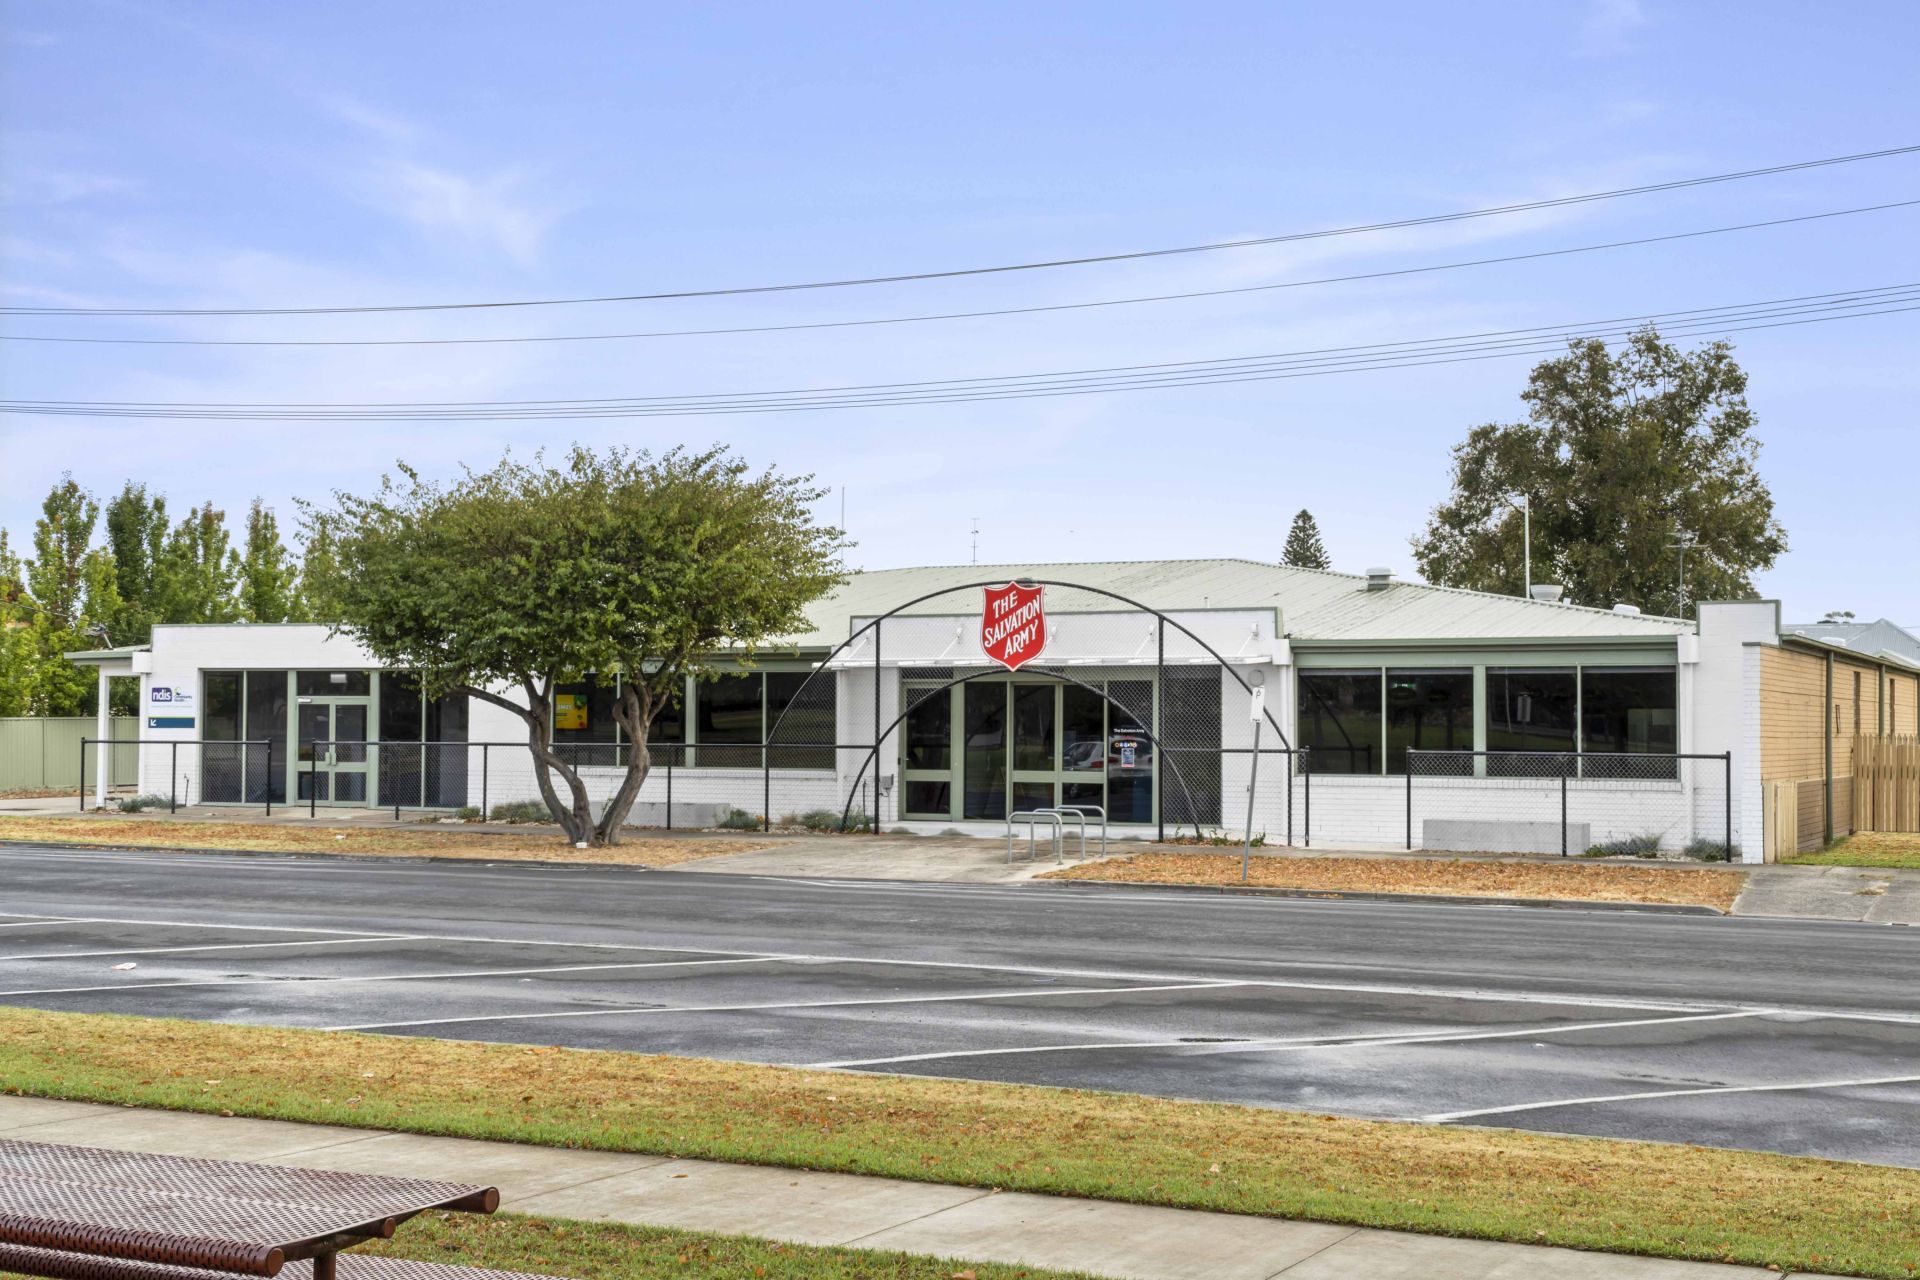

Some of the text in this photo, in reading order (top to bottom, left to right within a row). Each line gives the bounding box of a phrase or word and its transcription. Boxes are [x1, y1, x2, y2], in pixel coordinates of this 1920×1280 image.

[984, 594, 1040, 648] SALVATION
[993, 591, 1018, 619] THE
[1003, 619, 1039, 660] ARMY
[152, 689, 171, 701] ndis
